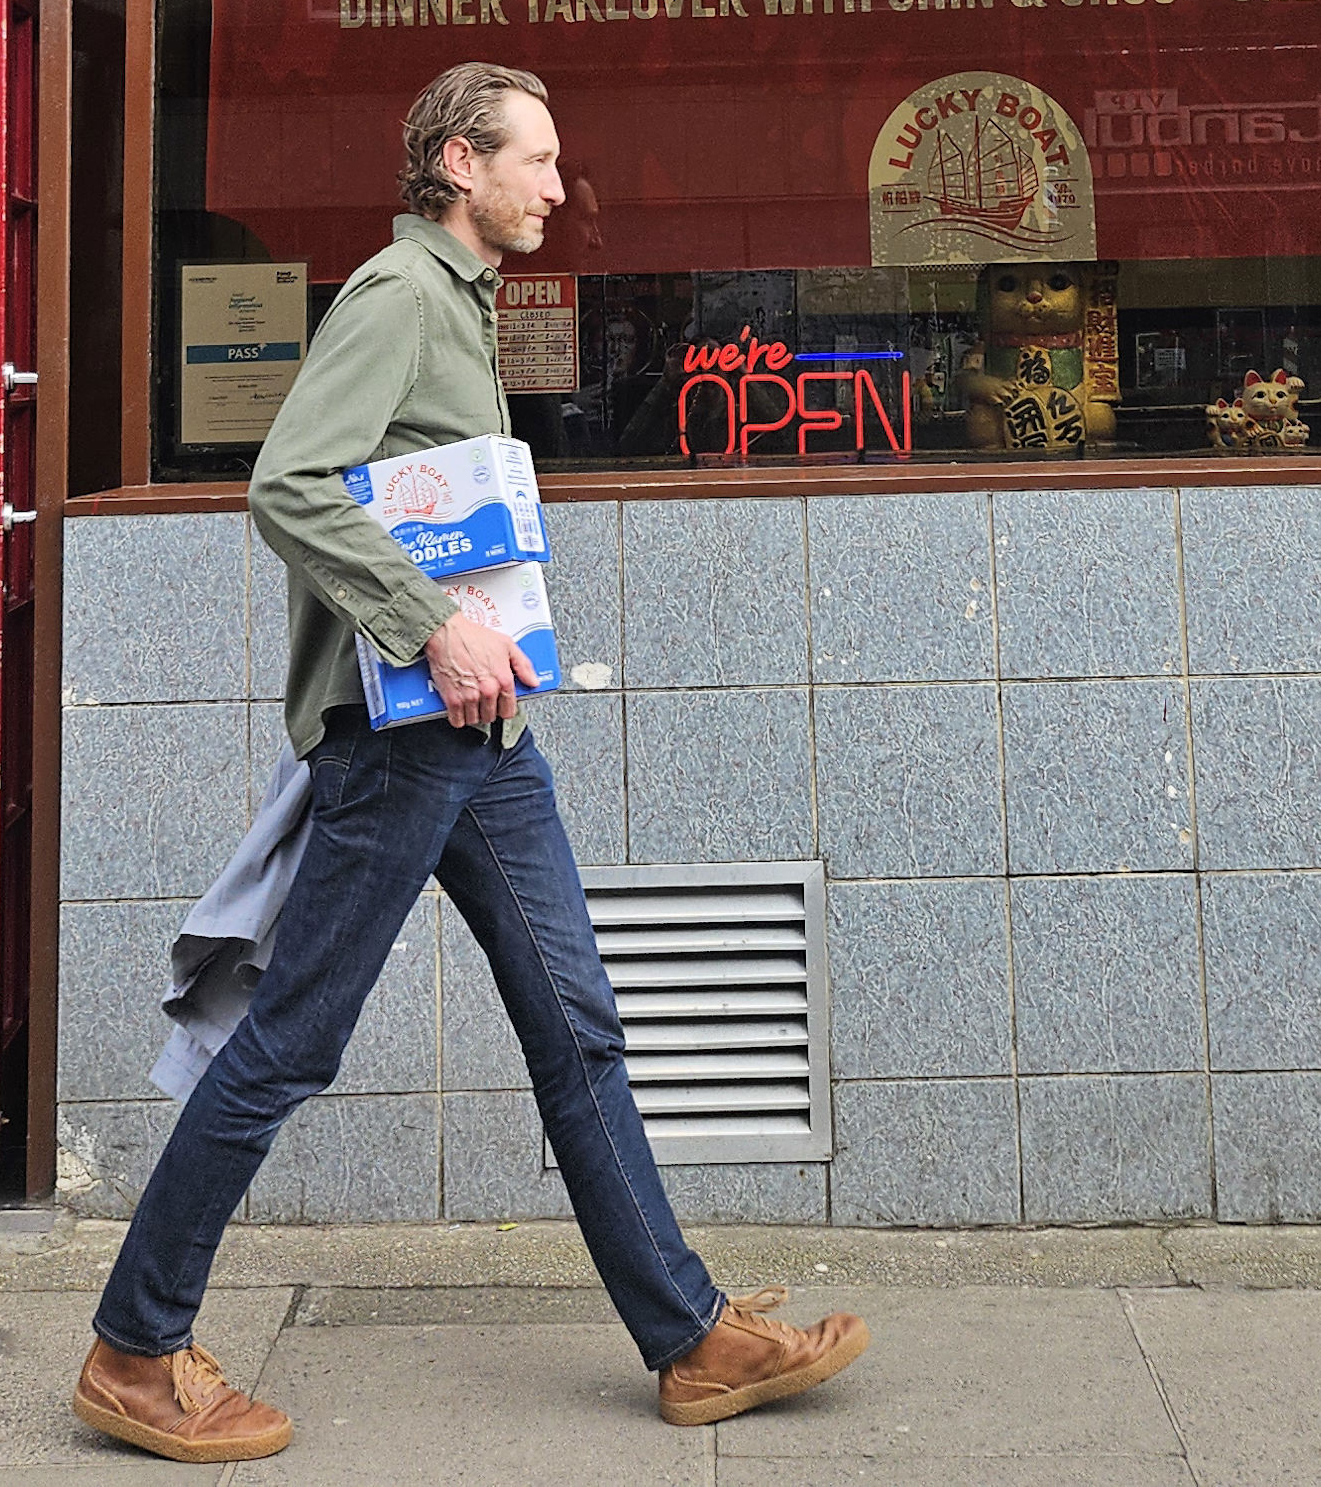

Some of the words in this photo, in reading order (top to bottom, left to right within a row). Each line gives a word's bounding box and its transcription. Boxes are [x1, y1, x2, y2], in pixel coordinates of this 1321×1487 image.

[888, 88, 983, 170] LUCKY
[995, 92, 1071, 166] BOAT
[505, 280, 562, 306] OPEN
[227, 347, 259, 360] PASS
[682, 324, 795, 374] we're
[678, 369, 912, 459] OPEN
[384, 464, 415, 501] LUCKY
[419, 464, 449, 489] BOAT
[410, 538, 473, 564] ODLES
[416, 529, 466, 549] Ramen
[467, 585, 497, 611] BOAT
